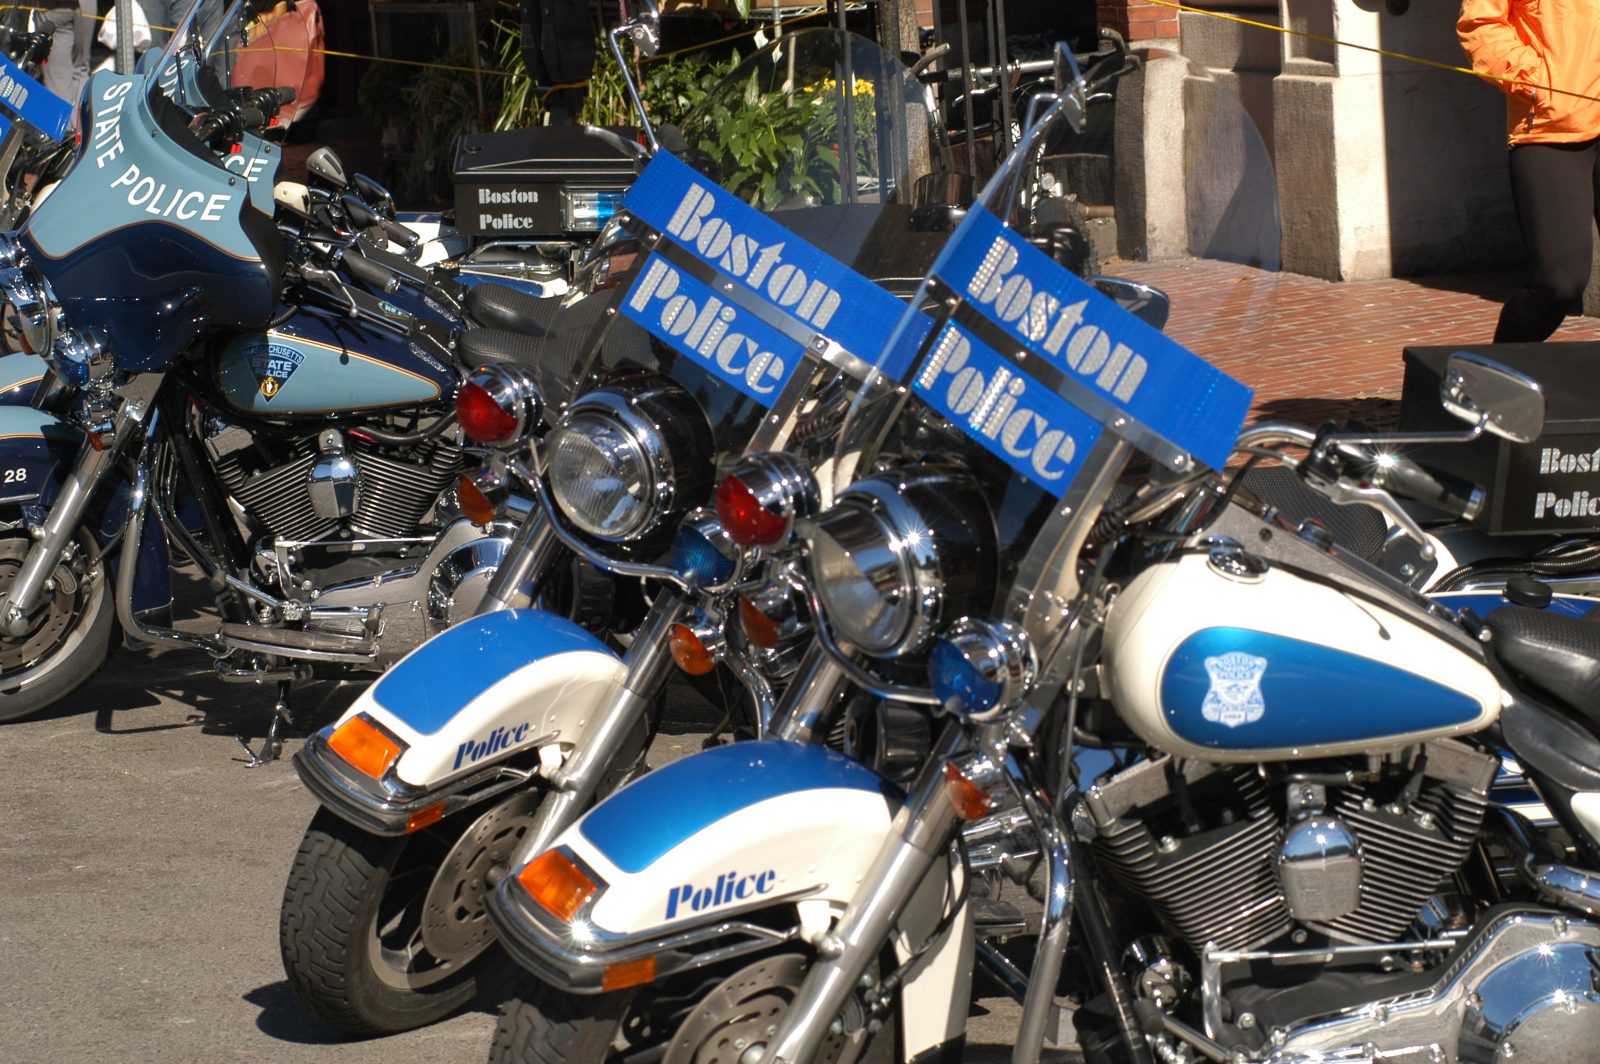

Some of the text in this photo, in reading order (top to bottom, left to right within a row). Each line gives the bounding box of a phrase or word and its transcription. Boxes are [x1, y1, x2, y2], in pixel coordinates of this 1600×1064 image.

[95, 82, 232, 221] STATE POLICE
[478, 188, 539, 204] Boston
[479, 213, 534, 230] Police
[666, 182, 842, 330] Boston
[629, 258, 785, 394] Police
[967, 236, 1148, 404] Boston
[252, 358, 293, 371] STATE
[255, 368, 289, 378] POLICE
[919, 326, 1076, 480] Police
[4, 468, 27, 483] 28
[453, 722, 529, 770] Police
[665, 870, 776, 920] Police
